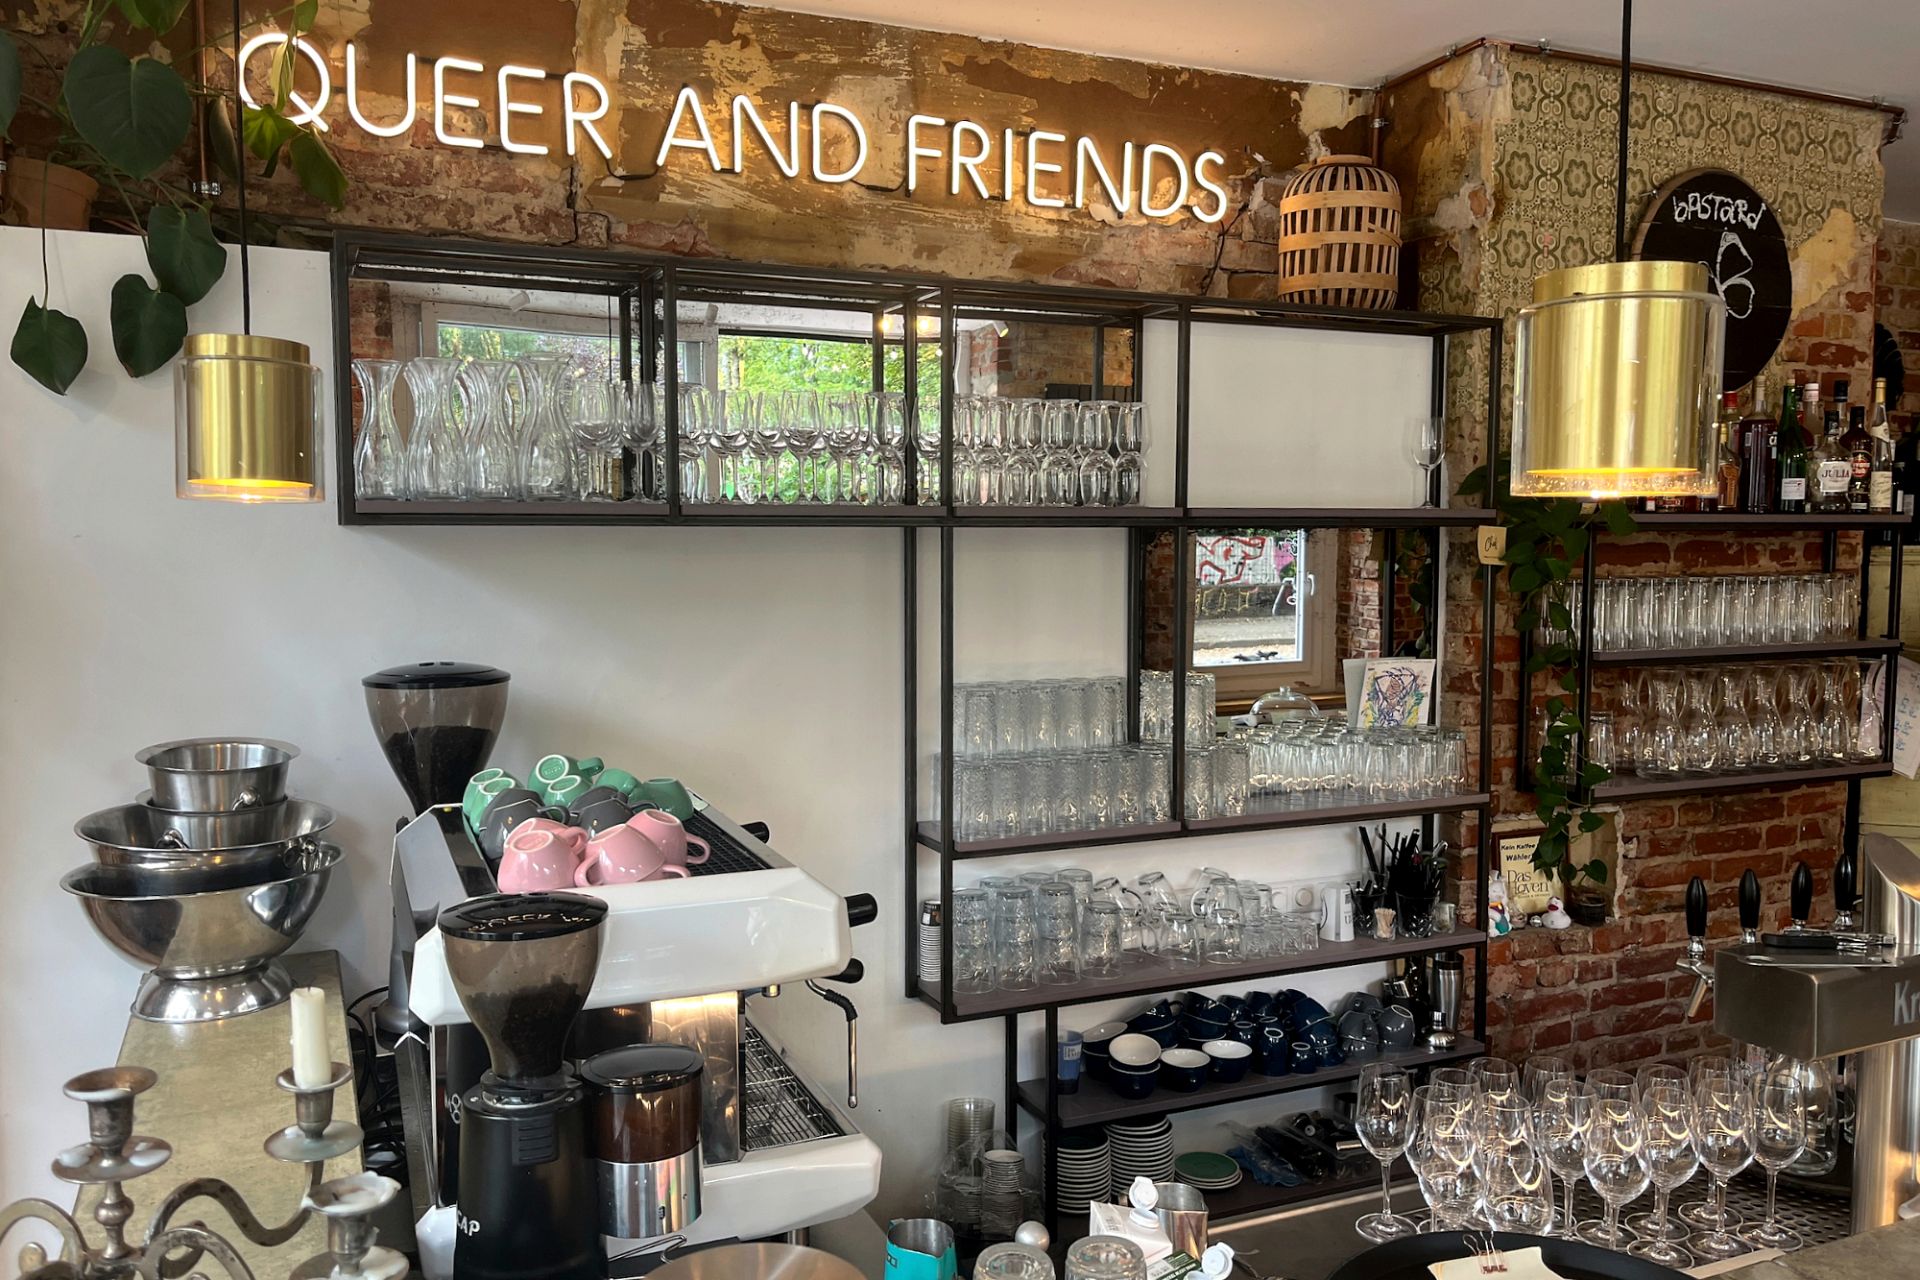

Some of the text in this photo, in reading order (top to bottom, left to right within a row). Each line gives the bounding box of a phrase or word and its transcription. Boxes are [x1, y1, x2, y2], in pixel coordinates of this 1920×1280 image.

[238, 32, 1227, 223] QUEER AND FRIENDS
[1822, 469, 1850, 478] JULIA
[1508, 870, 1532, 882] Das
[1894, 980, 1920, 1025] Kr
